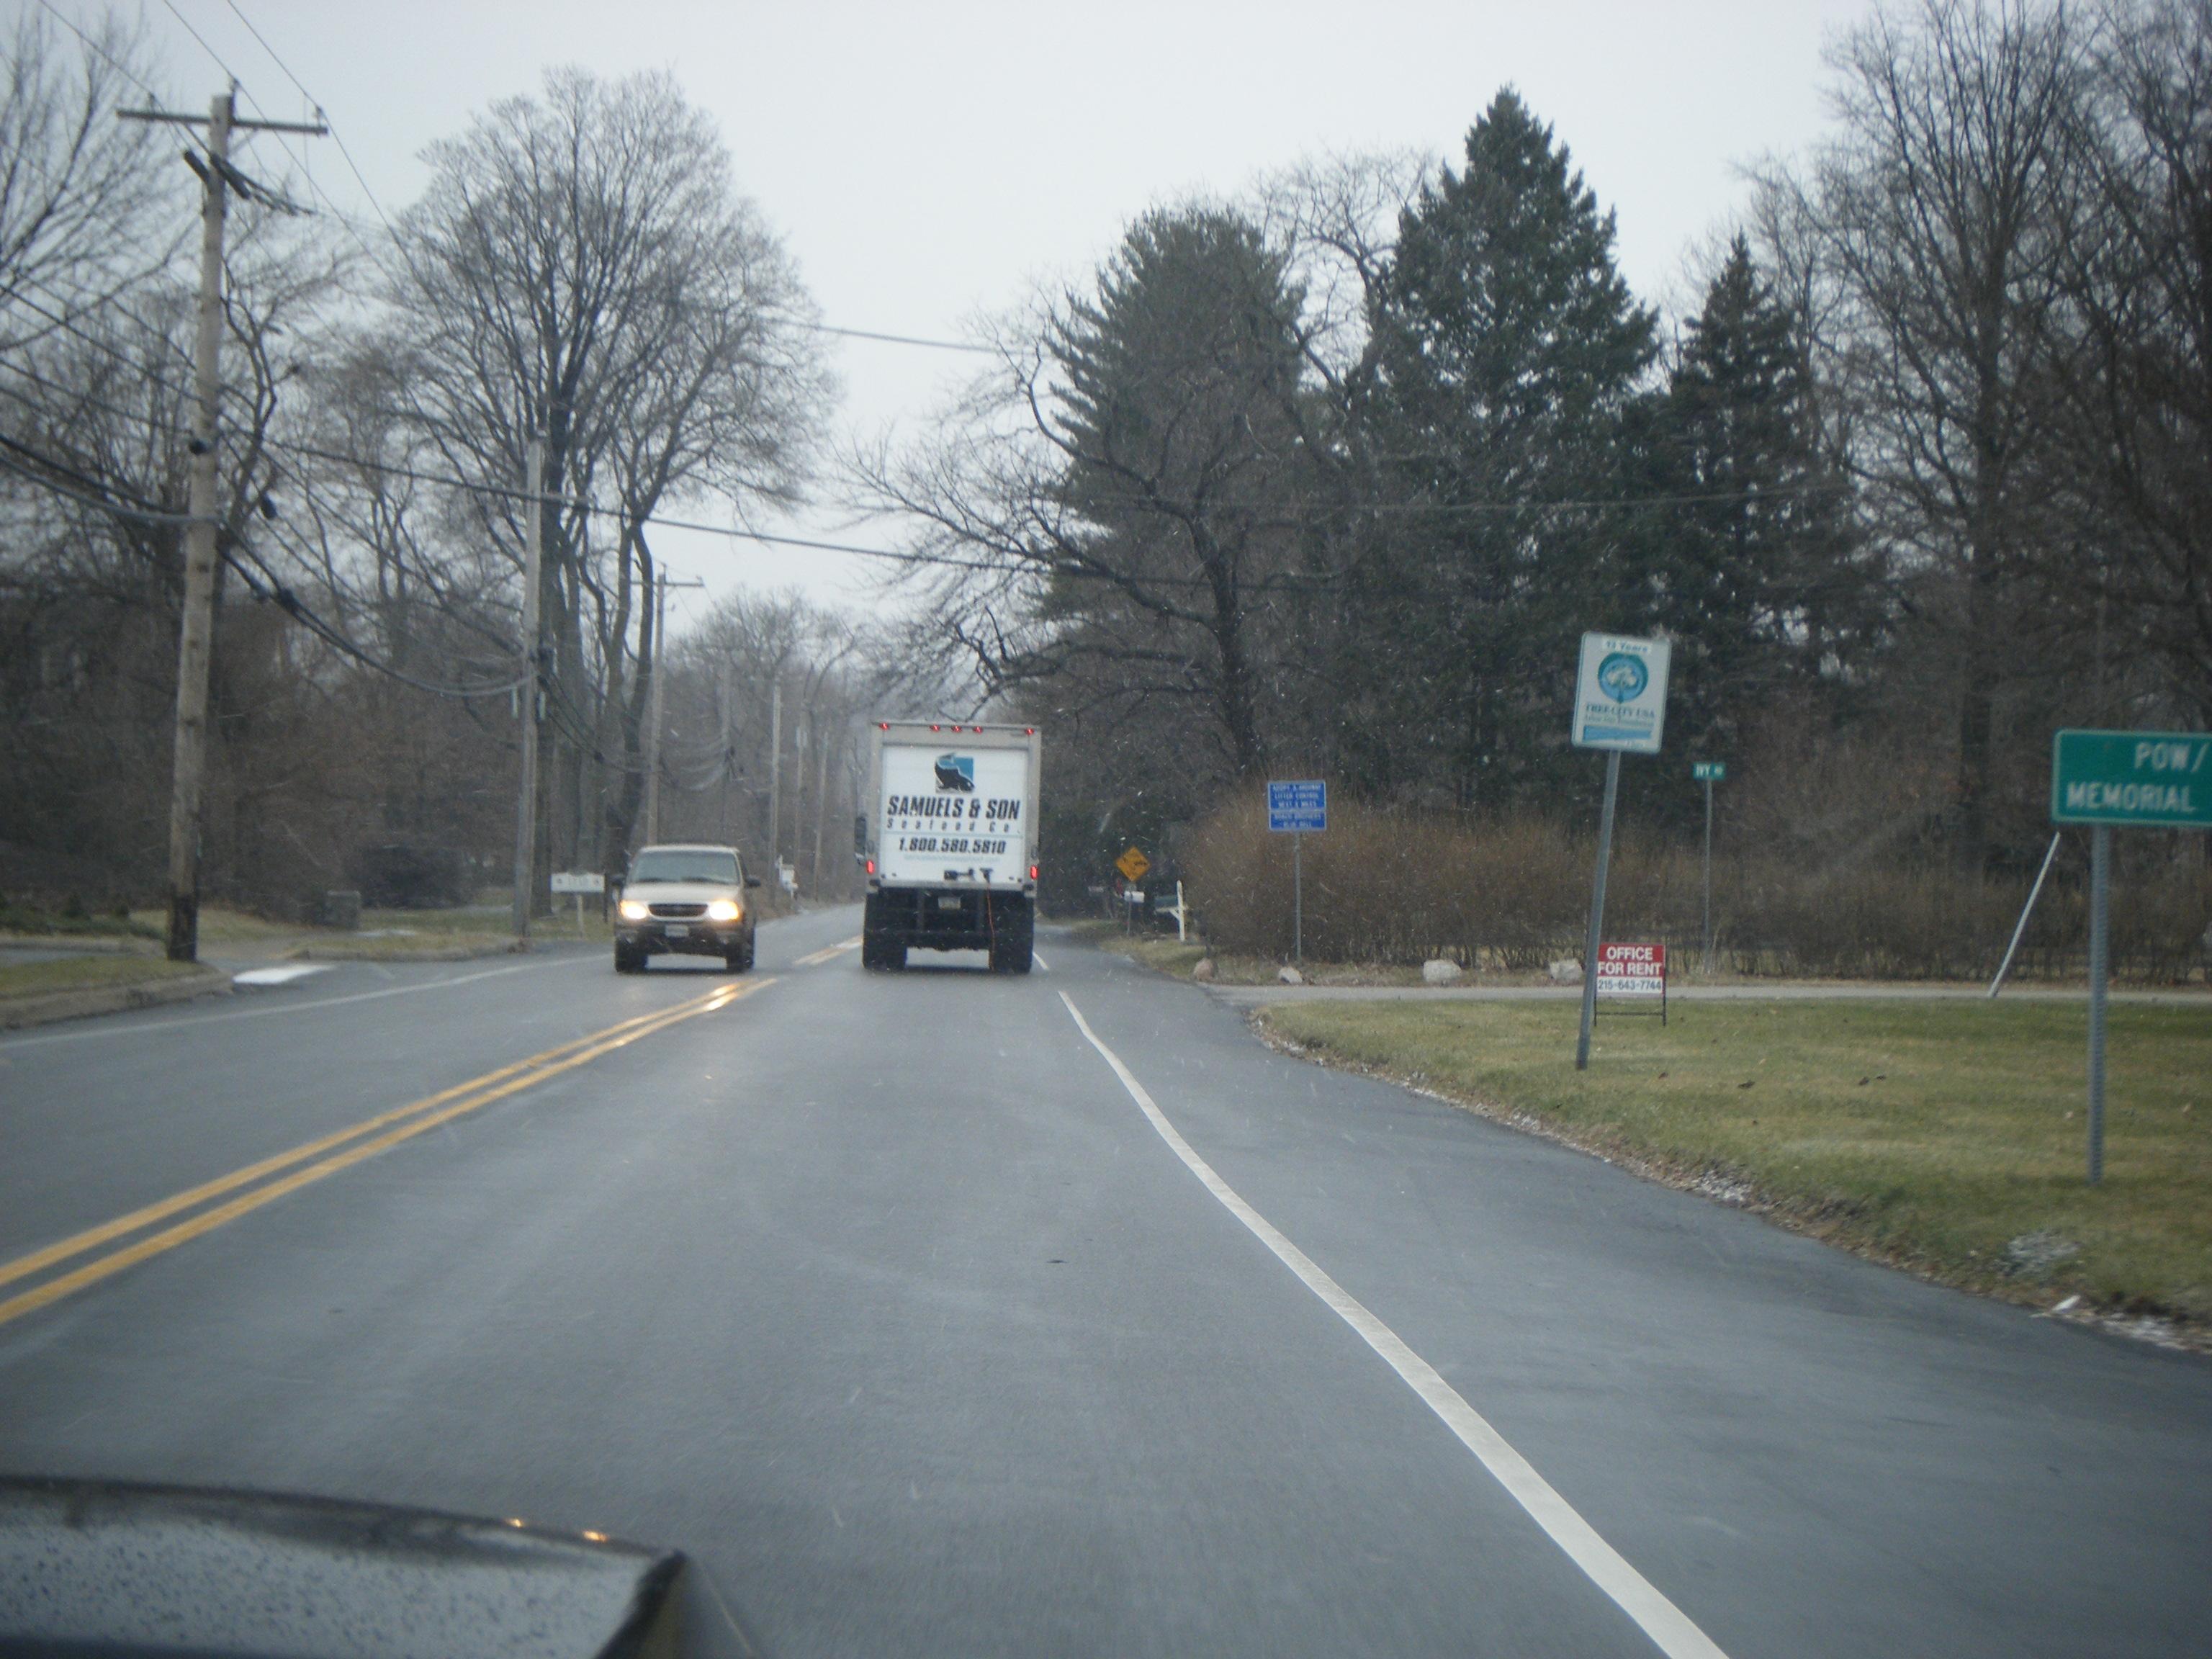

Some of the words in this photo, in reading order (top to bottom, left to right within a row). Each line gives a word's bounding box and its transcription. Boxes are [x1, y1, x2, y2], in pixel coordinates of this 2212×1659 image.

[2134, 742, 2210, 773] POW/
[887, 795, 964, 818] SAMUELS
[968, 798, 981, 819] &
[986, 799, 1020, 820] SON
[2067, 781, 2197, 814] MEMORIAL
[1606, 945, 1653, 961] OFFICE
[1598, 961, 1624, 975] FOR
[1627, 962, 1662, 976] RENT
